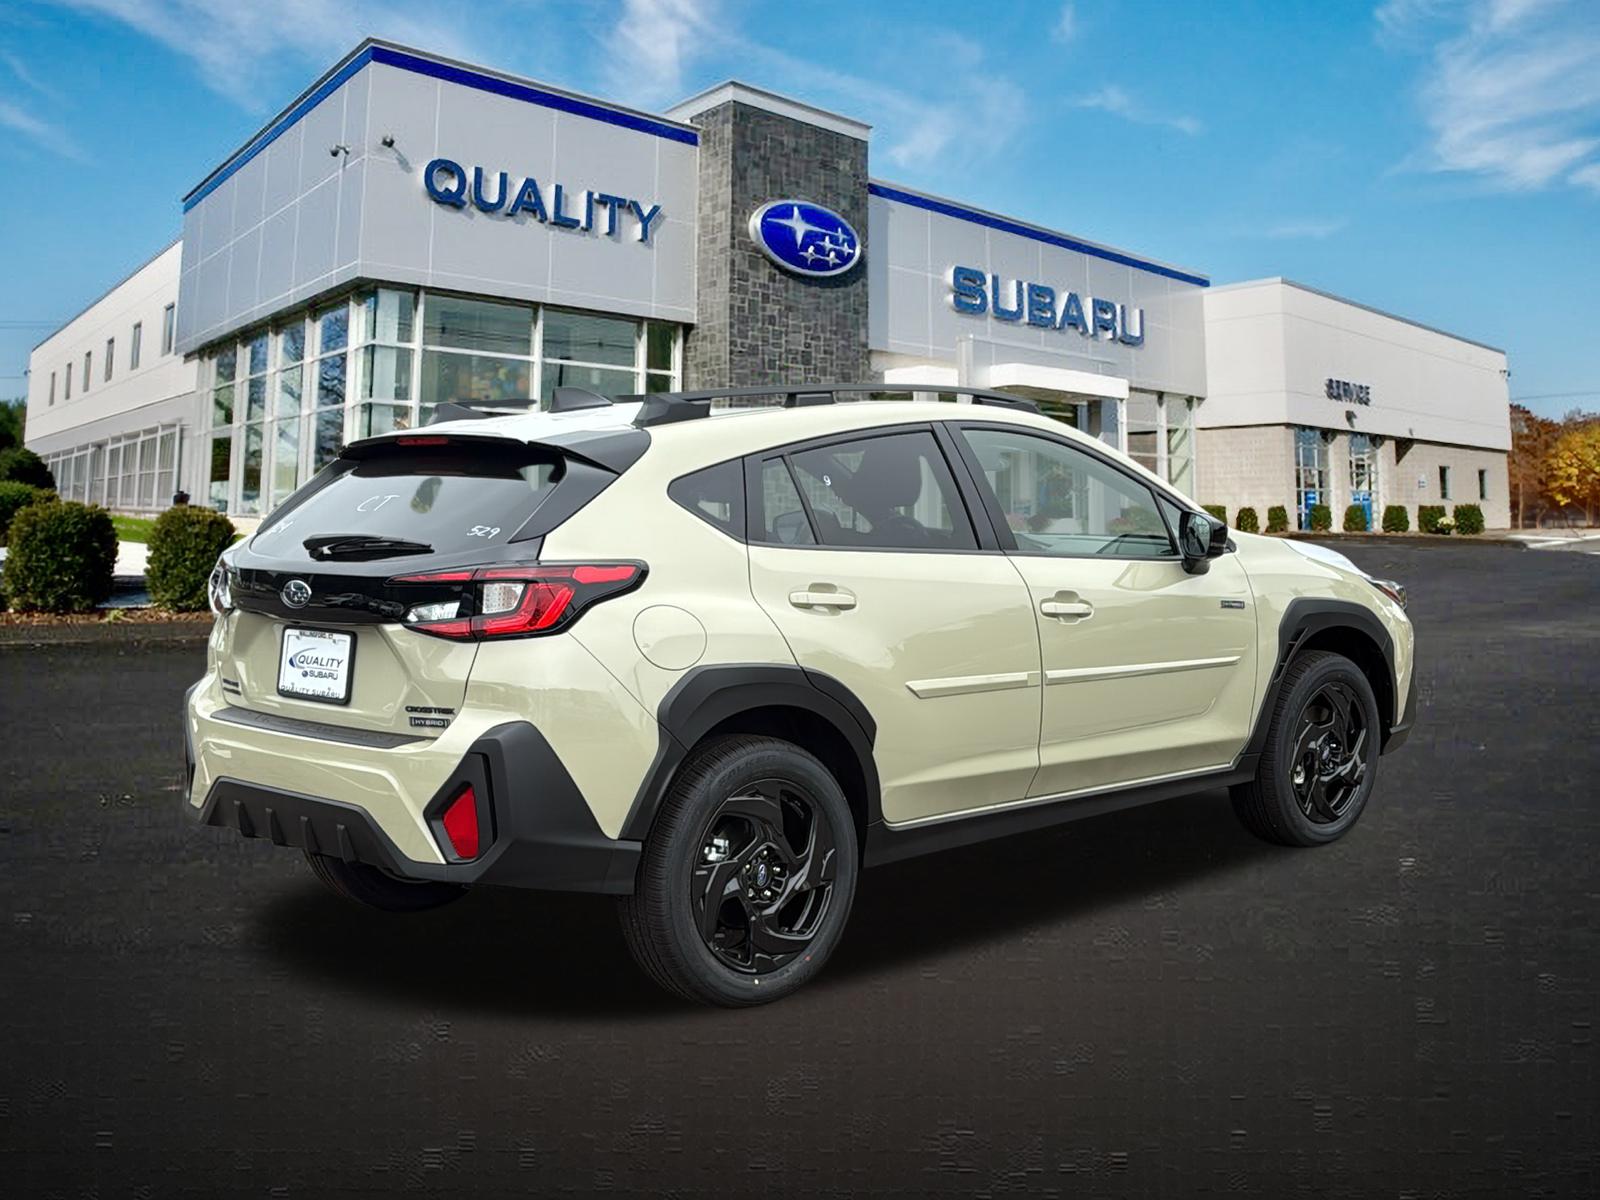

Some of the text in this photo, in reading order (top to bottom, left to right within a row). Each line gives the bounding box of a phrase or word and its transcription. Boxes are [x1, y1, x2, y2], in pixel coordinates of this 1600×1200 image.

[423, 158, 661, 243] QUALITY
[945, 265, 1146, 346] SUBARU
[297, 654, 344, 669] QUALITY
[308, 669, 339, 681] SUBARU
